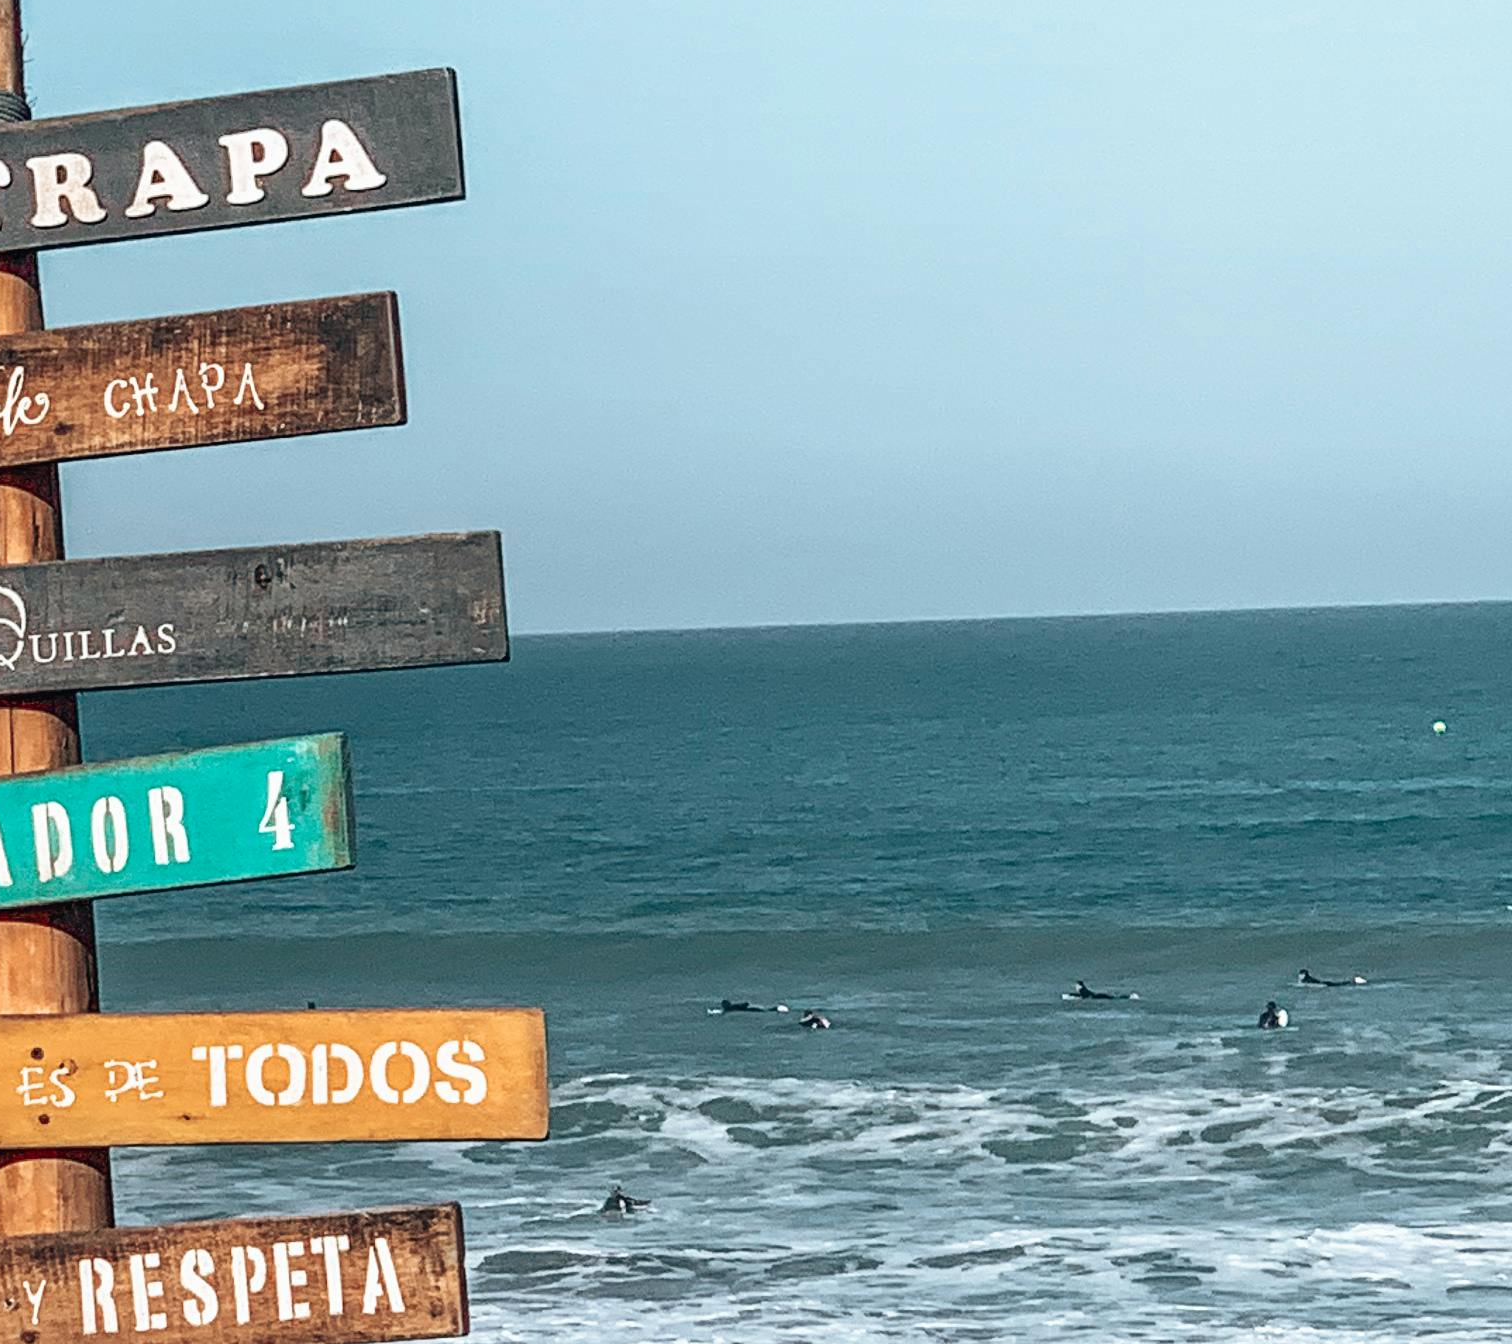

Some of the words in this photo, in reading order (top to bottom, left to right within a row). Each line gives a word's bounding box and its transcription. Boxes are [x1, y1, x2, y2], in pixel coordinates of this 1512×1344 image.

[102, 361, 266, 420] CHAPA
[257, 770, 296, 851] 4
[15, 1066, 77, 1109] ES
[103, 1058, 165, 1104] DE
[191, 1039, 489, 1108] TODOS
[77, 1233, 407, 1336] RESPETA
